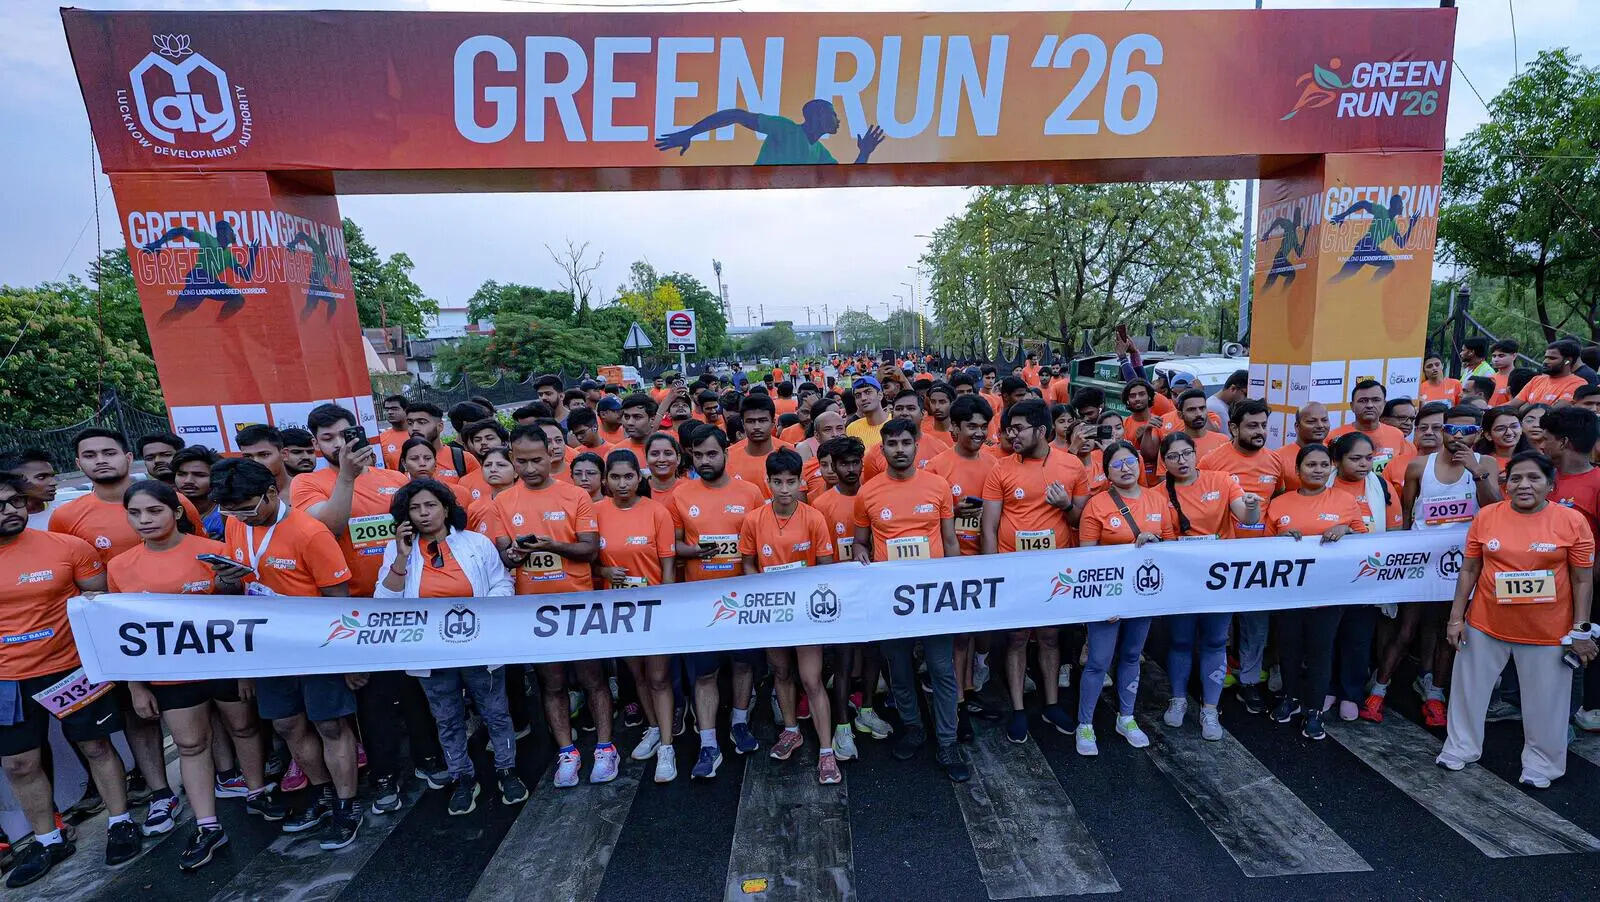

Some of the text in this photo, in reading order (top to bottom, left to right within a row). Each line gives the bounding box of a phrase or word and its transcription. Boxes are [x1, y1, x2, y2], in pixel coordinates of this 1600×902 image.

[1351, 60, 1447, 88] GREEN
[453, 33, 1164, 144] GREEN RUN '26
[1337, 90, 1439, 118] RUN '26
[117, 84, 253, 159] LUCKNOW DEVELOPMENT AUTHORITY
[1324, 184, 1440, 221] GREEN RUN
[128, 210, 279, 250] GREEN RUN
[277, 210, 320, 252] GREEN
[136, 246, 287, 286] GREEN RUN
[1429, 502, 1468, 518] 2097
[355, 522, 397, 541] 2080
[718, 542, 738, 556] 23
[896, 544, 920, 558] 1111
[1020, 537, 1051, 551] 1149
[1385, 551, 1431, 567] GREEN
[1077, 566, 1125, 583] GREEN
[1205, 558, 1316, 591] START
[1376, 567, 1407, 581] RUN
[1072, 585, 1103, 599] RUN
[1505, 580, 1545, 594] 1137
[744, 591, 796, 607] GREEN
[892, 577, 1005, 616] START
[366, 610, 428, 628] GREEN
[533, 599, 662, 638] START
[738, 609, 772, 626] RUN
[7, 630, 51, 643] HDFC BANK
[118, 618, 269, 657] START
[356, 627, 398, 645] RUN
[52, 677, 100, 708] 2132
